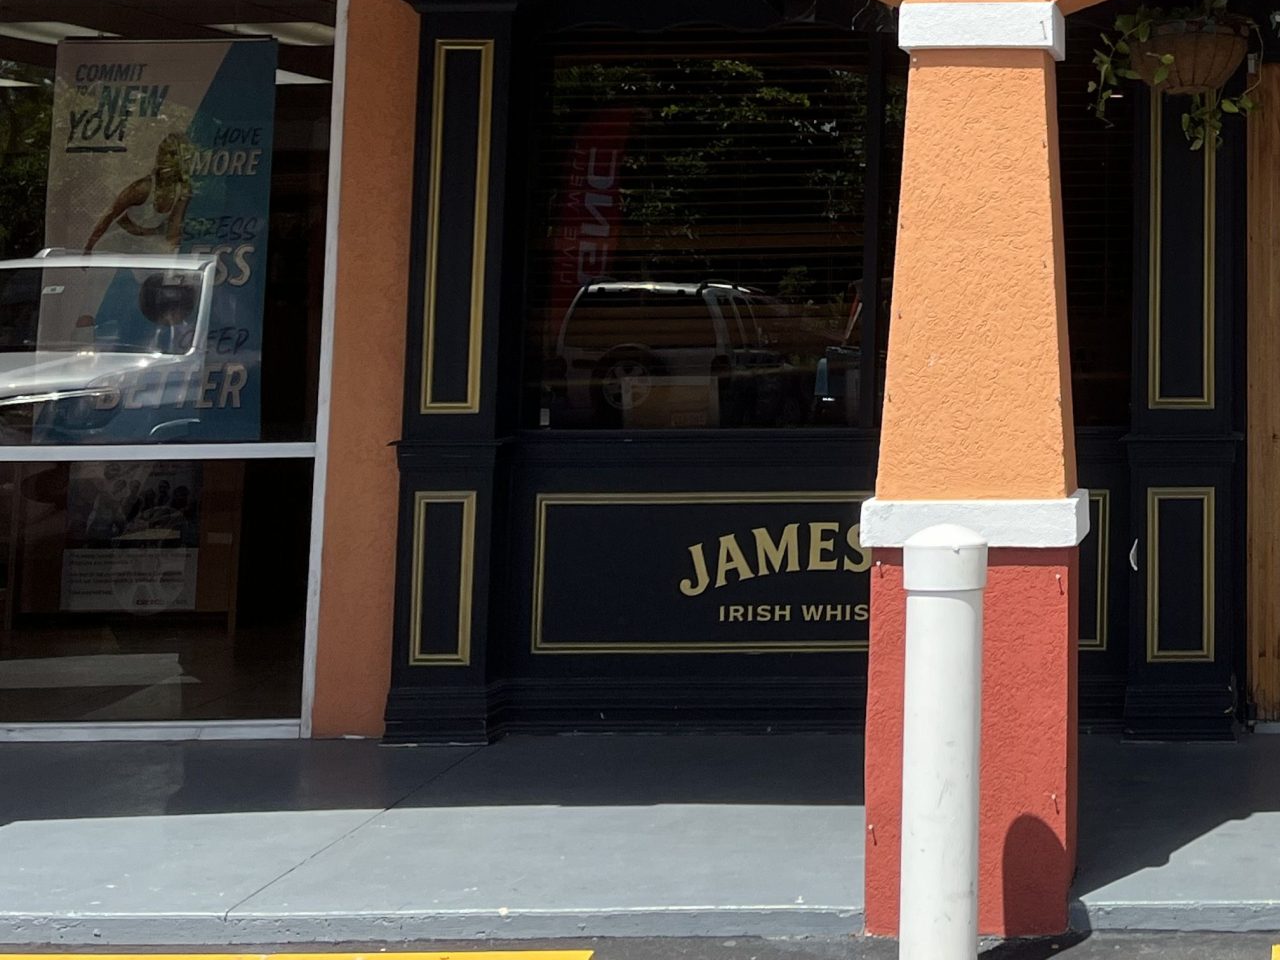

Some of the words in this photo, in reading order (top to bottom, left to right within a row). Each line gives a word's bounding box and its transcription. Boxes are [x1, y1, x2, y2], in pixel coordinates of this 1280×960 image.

[75, 64, 148, 82] COMMIT
[97, 85, 169, 117] NEW
[67, 110, 130, 144] YOU
[214, 127, 263, 146] MOVE
[188, 148, 261, 177] MORE
[719, 604, 791, 622] IRISH
[801, 604, 869, 621] WHIS
